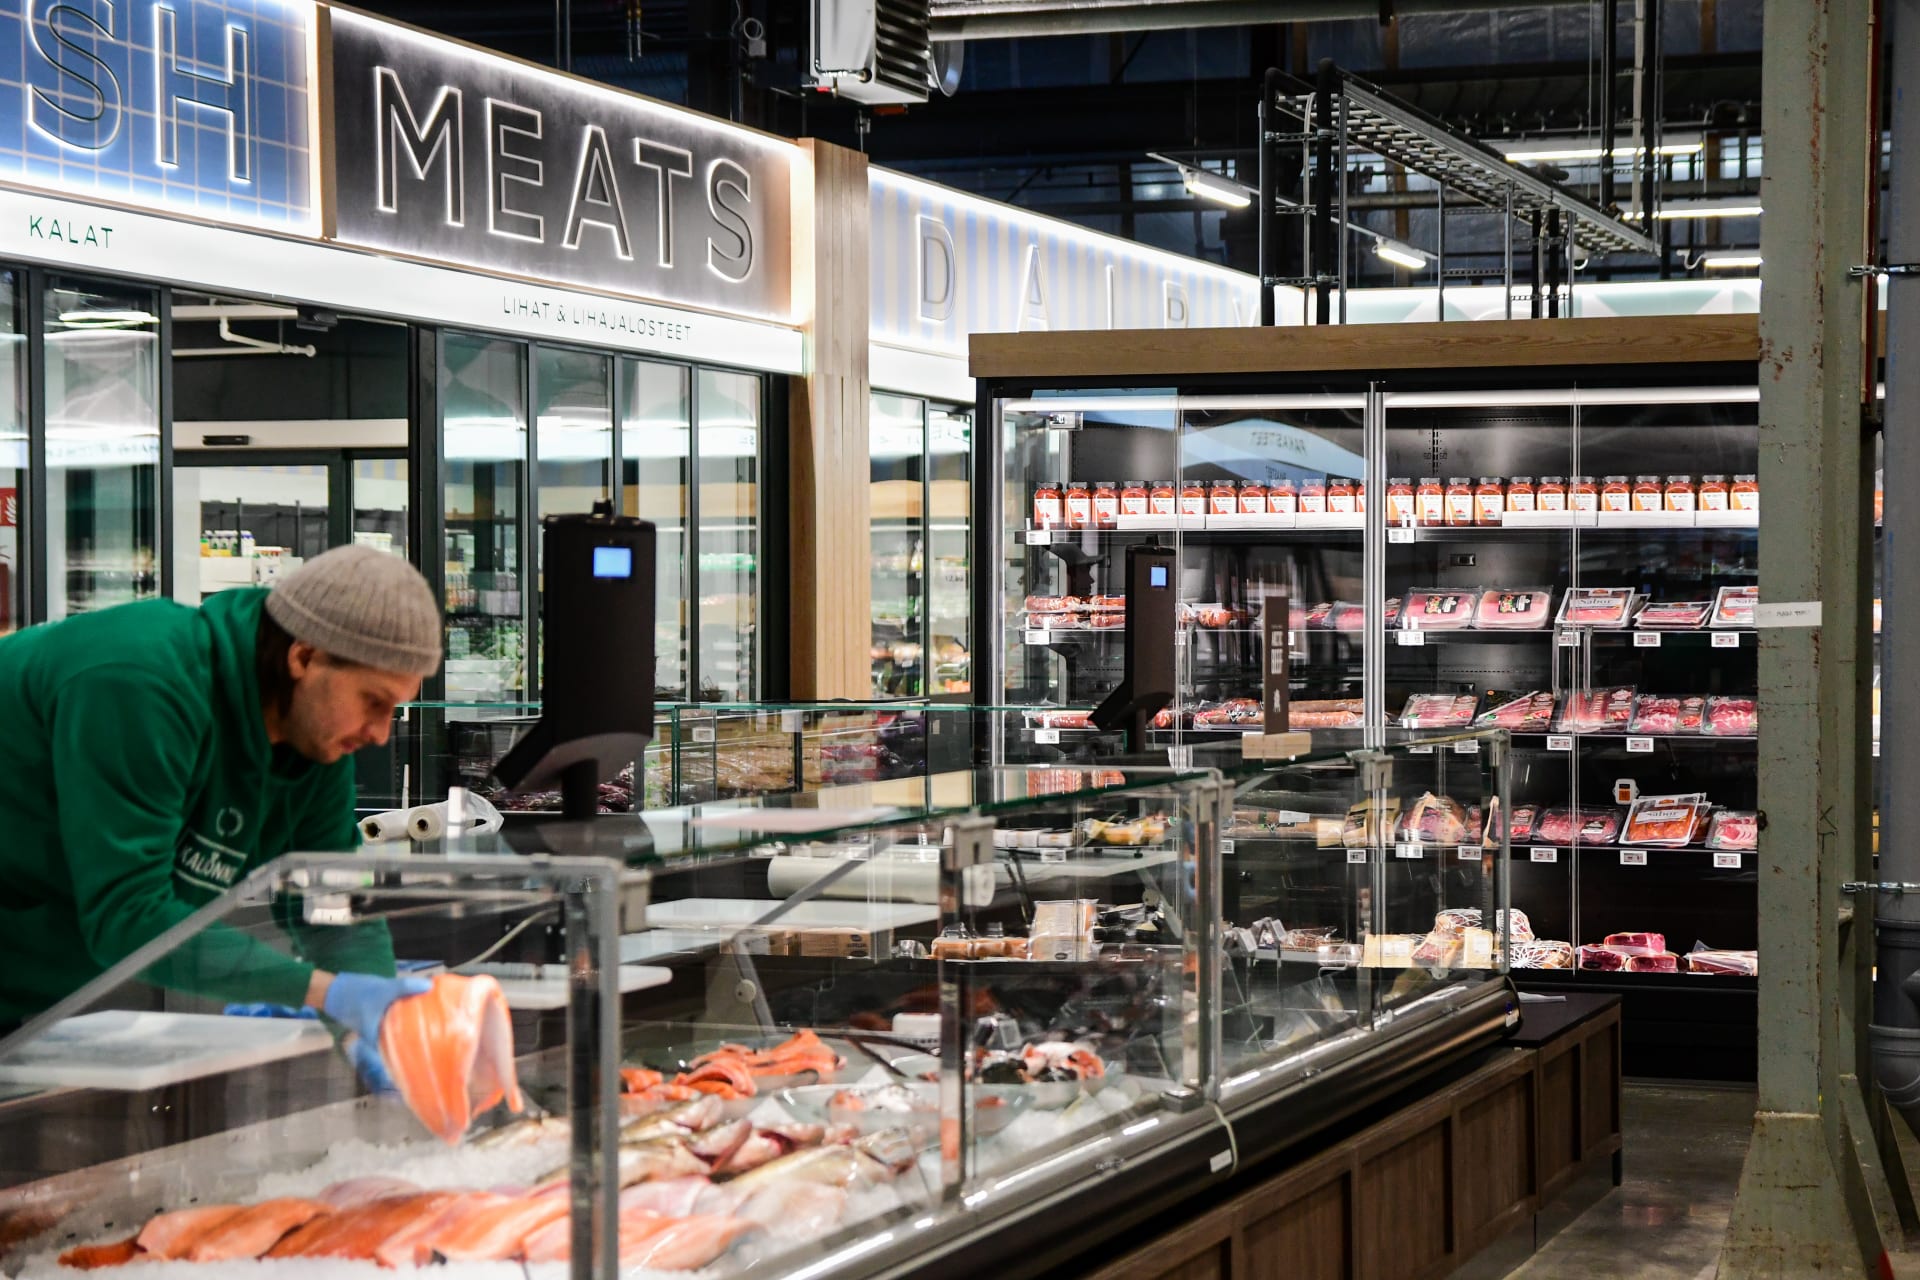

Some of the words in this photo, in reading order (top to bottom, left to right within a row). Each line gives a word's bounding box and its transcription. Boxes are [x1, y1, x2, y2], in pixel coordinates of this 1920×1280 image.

[374, 65, 756, 284] MEATS
[30, 214, 114, 248] KALAT
[503, 295, 551, 321] LIHAT
[557, 304, 568, 323] &
[572, 308, 692, 341] LIHAJALOSTEET
